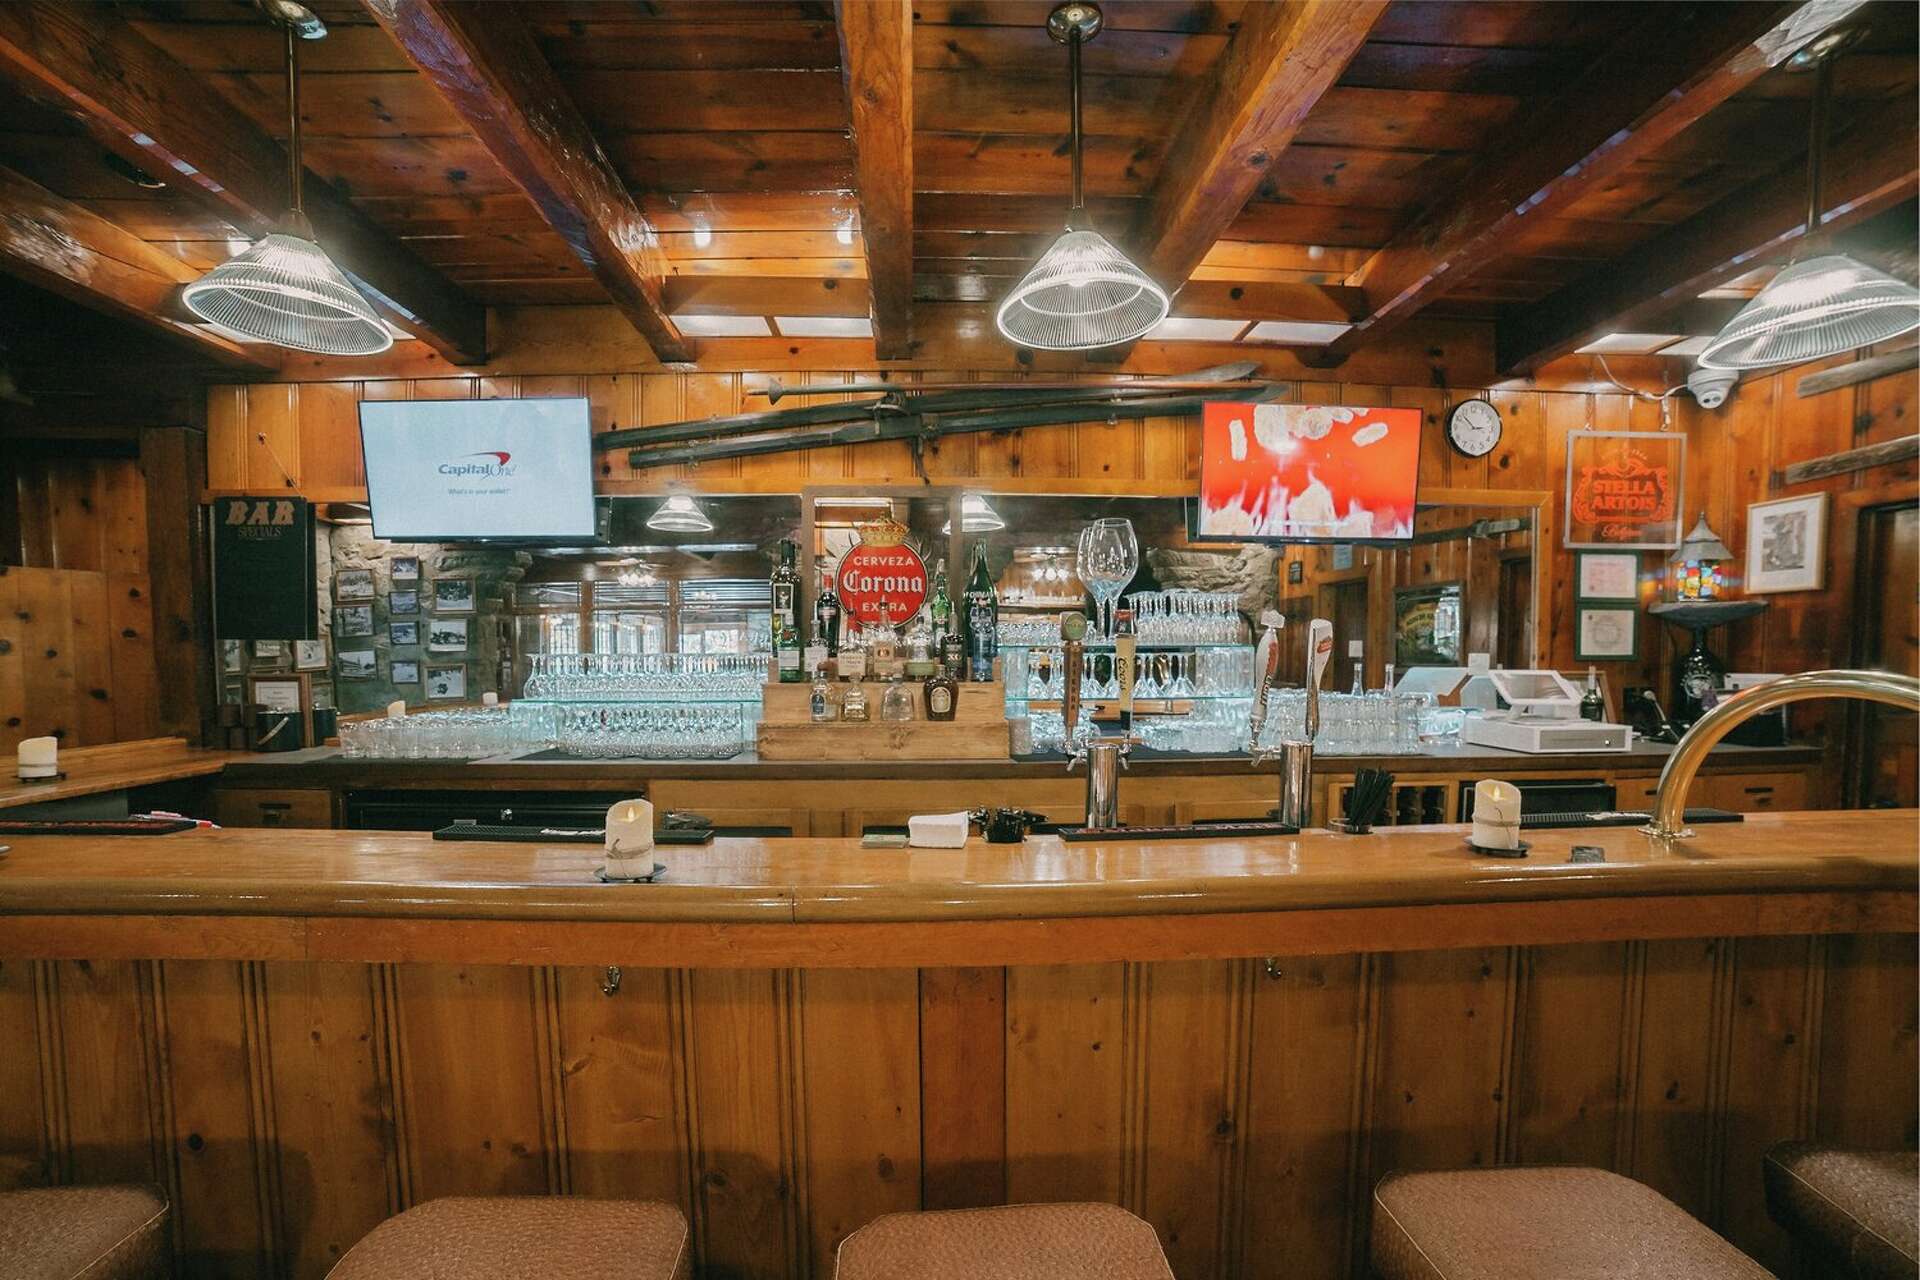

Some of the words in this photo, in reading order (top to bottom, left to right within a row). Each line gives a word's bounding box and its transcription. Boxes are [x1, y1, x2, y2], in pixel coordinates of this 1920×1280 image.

[438, 464, 489, 476] Capital
[1592, 479, 1656, 494] STELLA
[1591, 495, 1657, 511] ARTOIS
[225, 501, 295, 525] BAR
[853, 556, 915, 566] CERVEZA
[843, 569, 922, 595] Corona
[862, 602, 908, 612] EXRA
